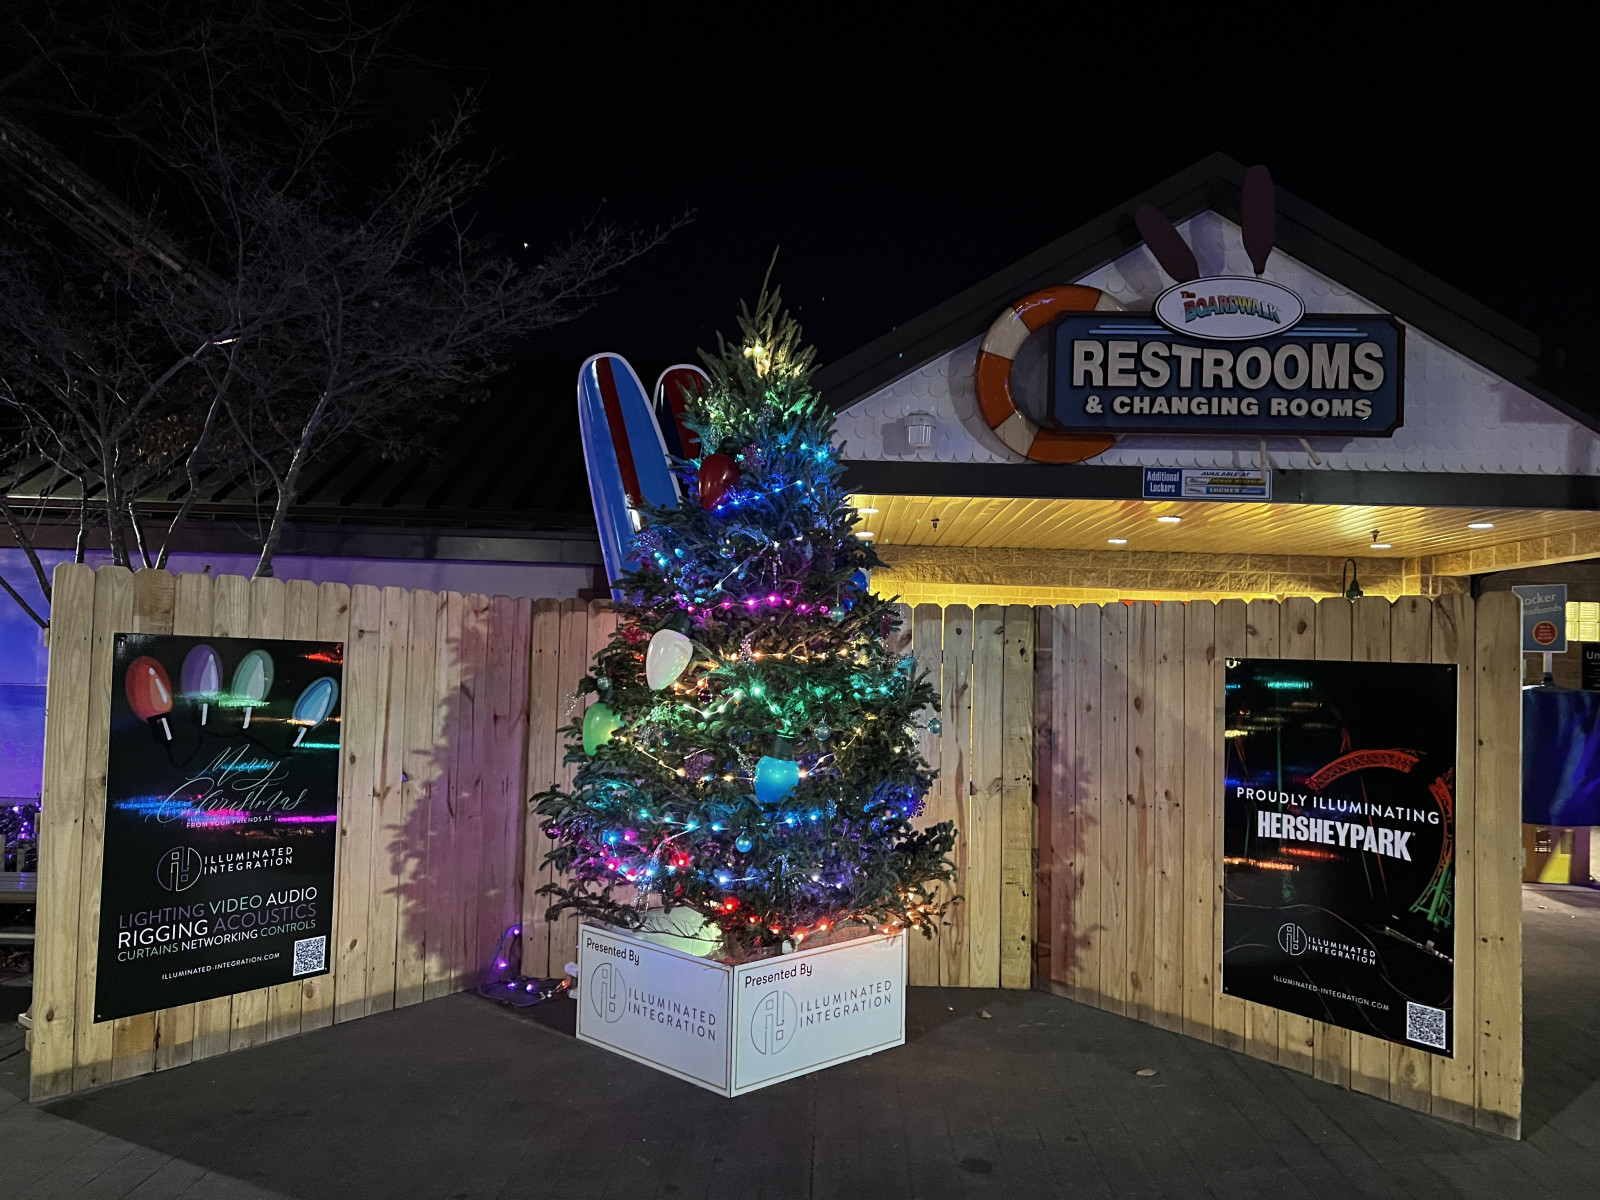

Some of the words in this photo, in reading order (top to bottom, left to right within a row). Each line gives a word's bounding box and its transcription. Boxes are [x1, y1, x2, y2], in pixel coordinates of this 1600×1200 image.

[1184, 295, 1281, 324] BOARDWALK
[1072, 340, 1385, 391] RESTROOMS
[1085, 395, 1103, 414] &
[1113, 396, 1259, 416] CHANGING
[1271, 398, 1372, 418] ROOMS
[1147, 471, 1179, 482] Additional
[1523, 592, 1556, 606] ocker
[185, 743, 289, 790] Merry
[145, 776, 308, 823] Christmas
[1237, 787, 1307, 807] PROUDLY
[1313, 796, 1439, 825] ILLUMINATING
[186, 821, 208, 829] FROM
[232, 816, 262, 825] FRIENDS
[1257, 810, 1412, 862] HERSHEYPARK
[204, 846, 293, 864] ILLUMINATED
[204, 856, 293, 875] INTEGRATION
[119, 903, 205, 929] LIGHTING
[209, 894, 262, 915] VIDEO
[266, 886, 317, 907] AUDIO
[117, 942, 179, 962] CURTAINS
[181, 929, 258, 951] NETWORKING
[260, 919, 316, 937] CONTROLS
[118, 919, 208, 949] RIGGING
[213, 902, 317, 933] ACOUSTICS
[586, 937, 627, 960] Presented
[628, 948, 640, 966] By
[1308, 936, 1376, 958] ILLUMINATED
[1308, 944, 1376, 965] INTEGRATION
[162, 952, 280, 980] ILLUMINATED-INTEGRATION.COM
[745, 965, 797, 988] Presented
[800, 963, 813, 978] By
[629, 987, 716, 1026] ILLUMINATED
[800, 980, 892, 1012] ILLUMINATED
[1273, 975, 1389, 1011] ILLUMINATED-INTEGRATION.COM
[628, 1001, 716, 1041] INTEGRATION
[800, 995, 892, 1028] INTEGRATION
